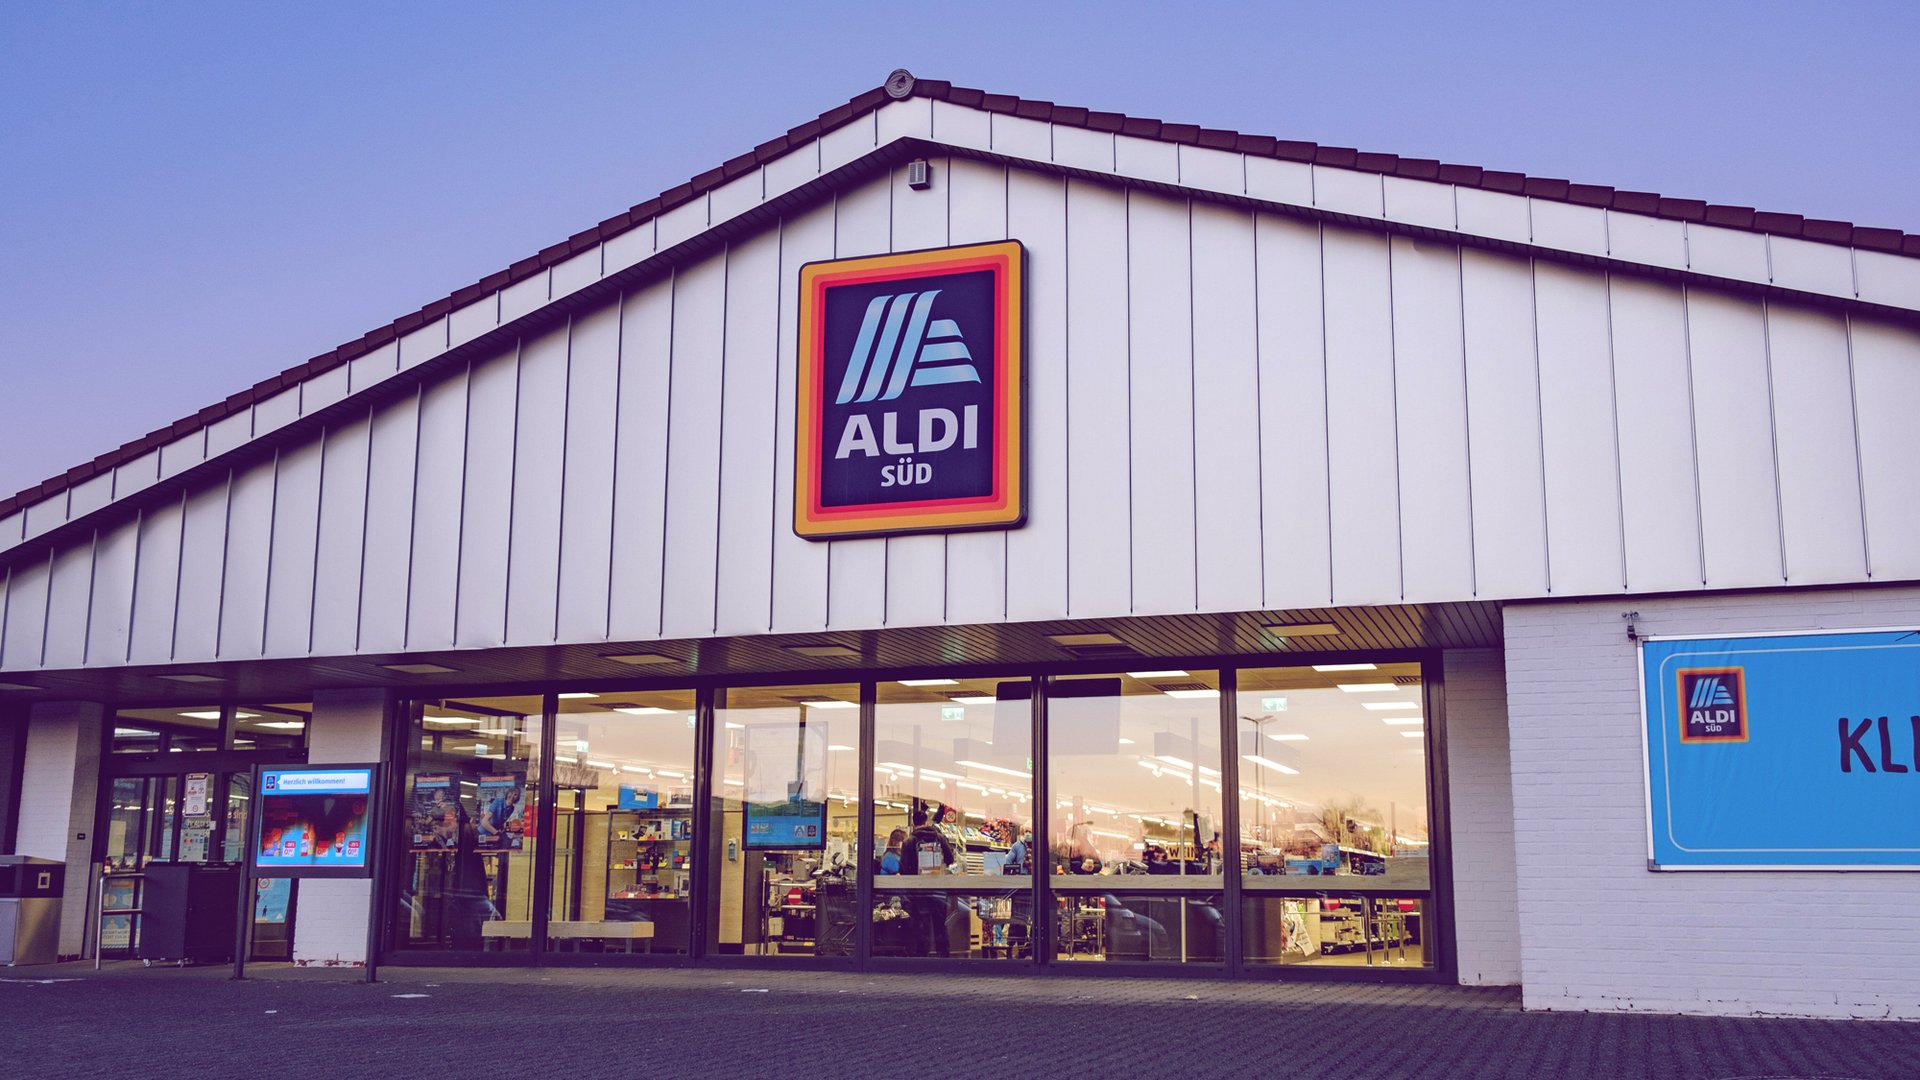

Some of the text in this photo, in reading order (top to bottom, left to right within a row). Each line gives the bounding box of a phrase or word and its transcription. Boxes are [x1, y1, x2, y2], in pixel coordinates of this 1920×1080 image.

[835, 405, 978, 459] ALDI
[880, 457, 933, 487] SÜD
[1690, 710, 1736, 724] ALDI
[1705, 724, 1722, 733] SÜD
